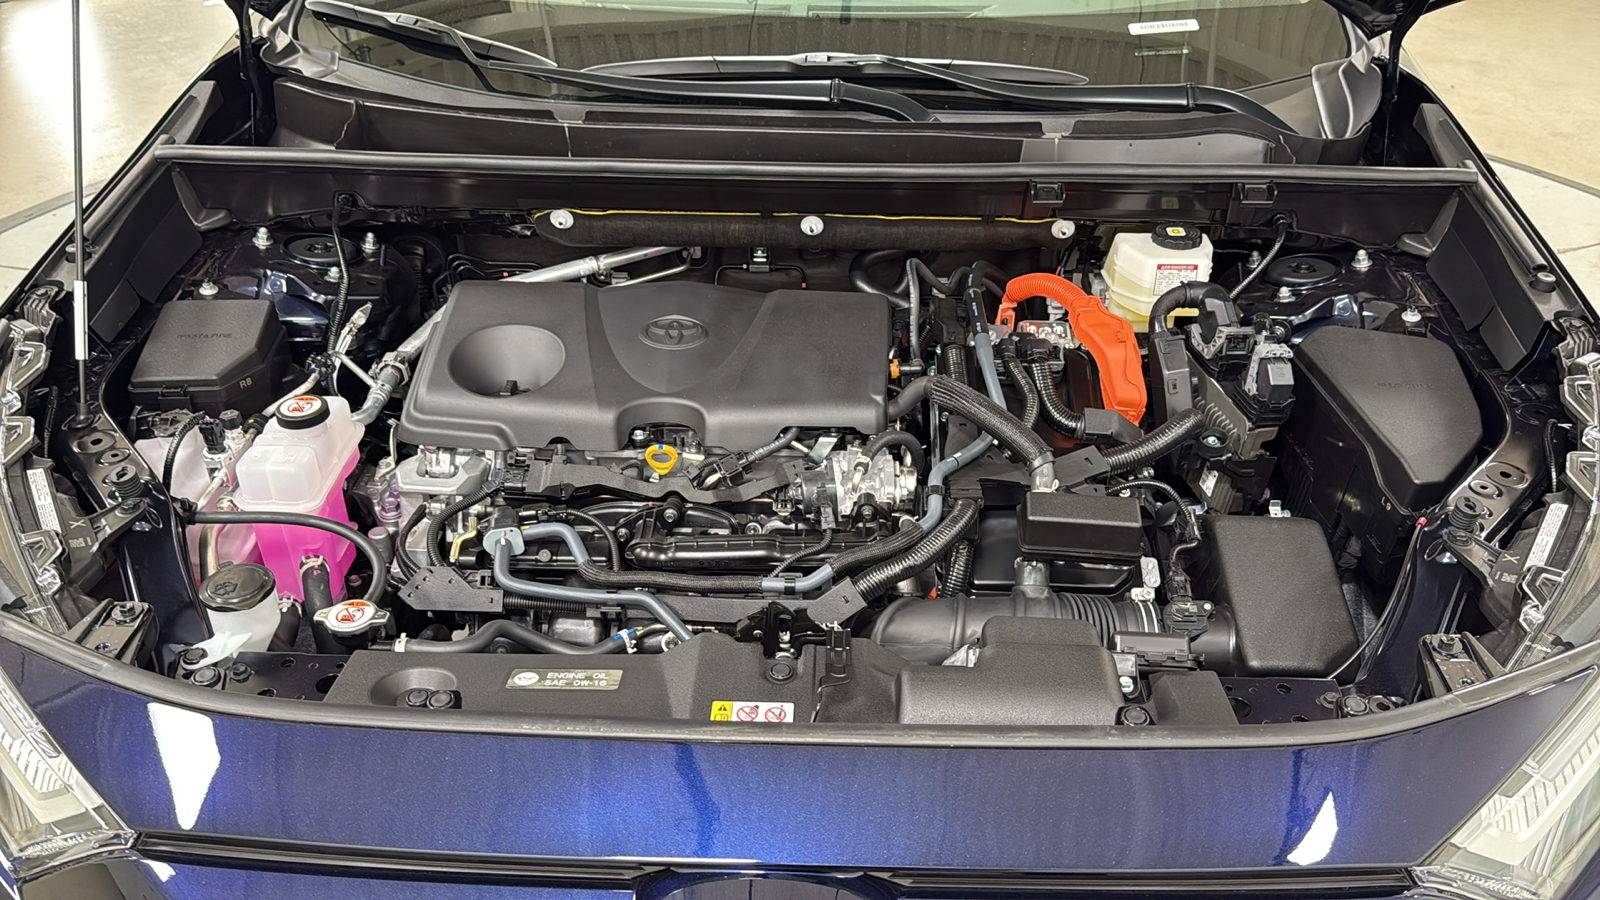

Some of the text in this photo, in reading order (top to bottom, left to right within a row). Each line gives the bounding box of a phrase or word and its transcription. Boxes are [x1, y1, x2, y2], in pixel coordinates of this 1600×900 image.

[239, 377, 253, 390] R8
[546, 672, 609, 680] ENGINE OIL
